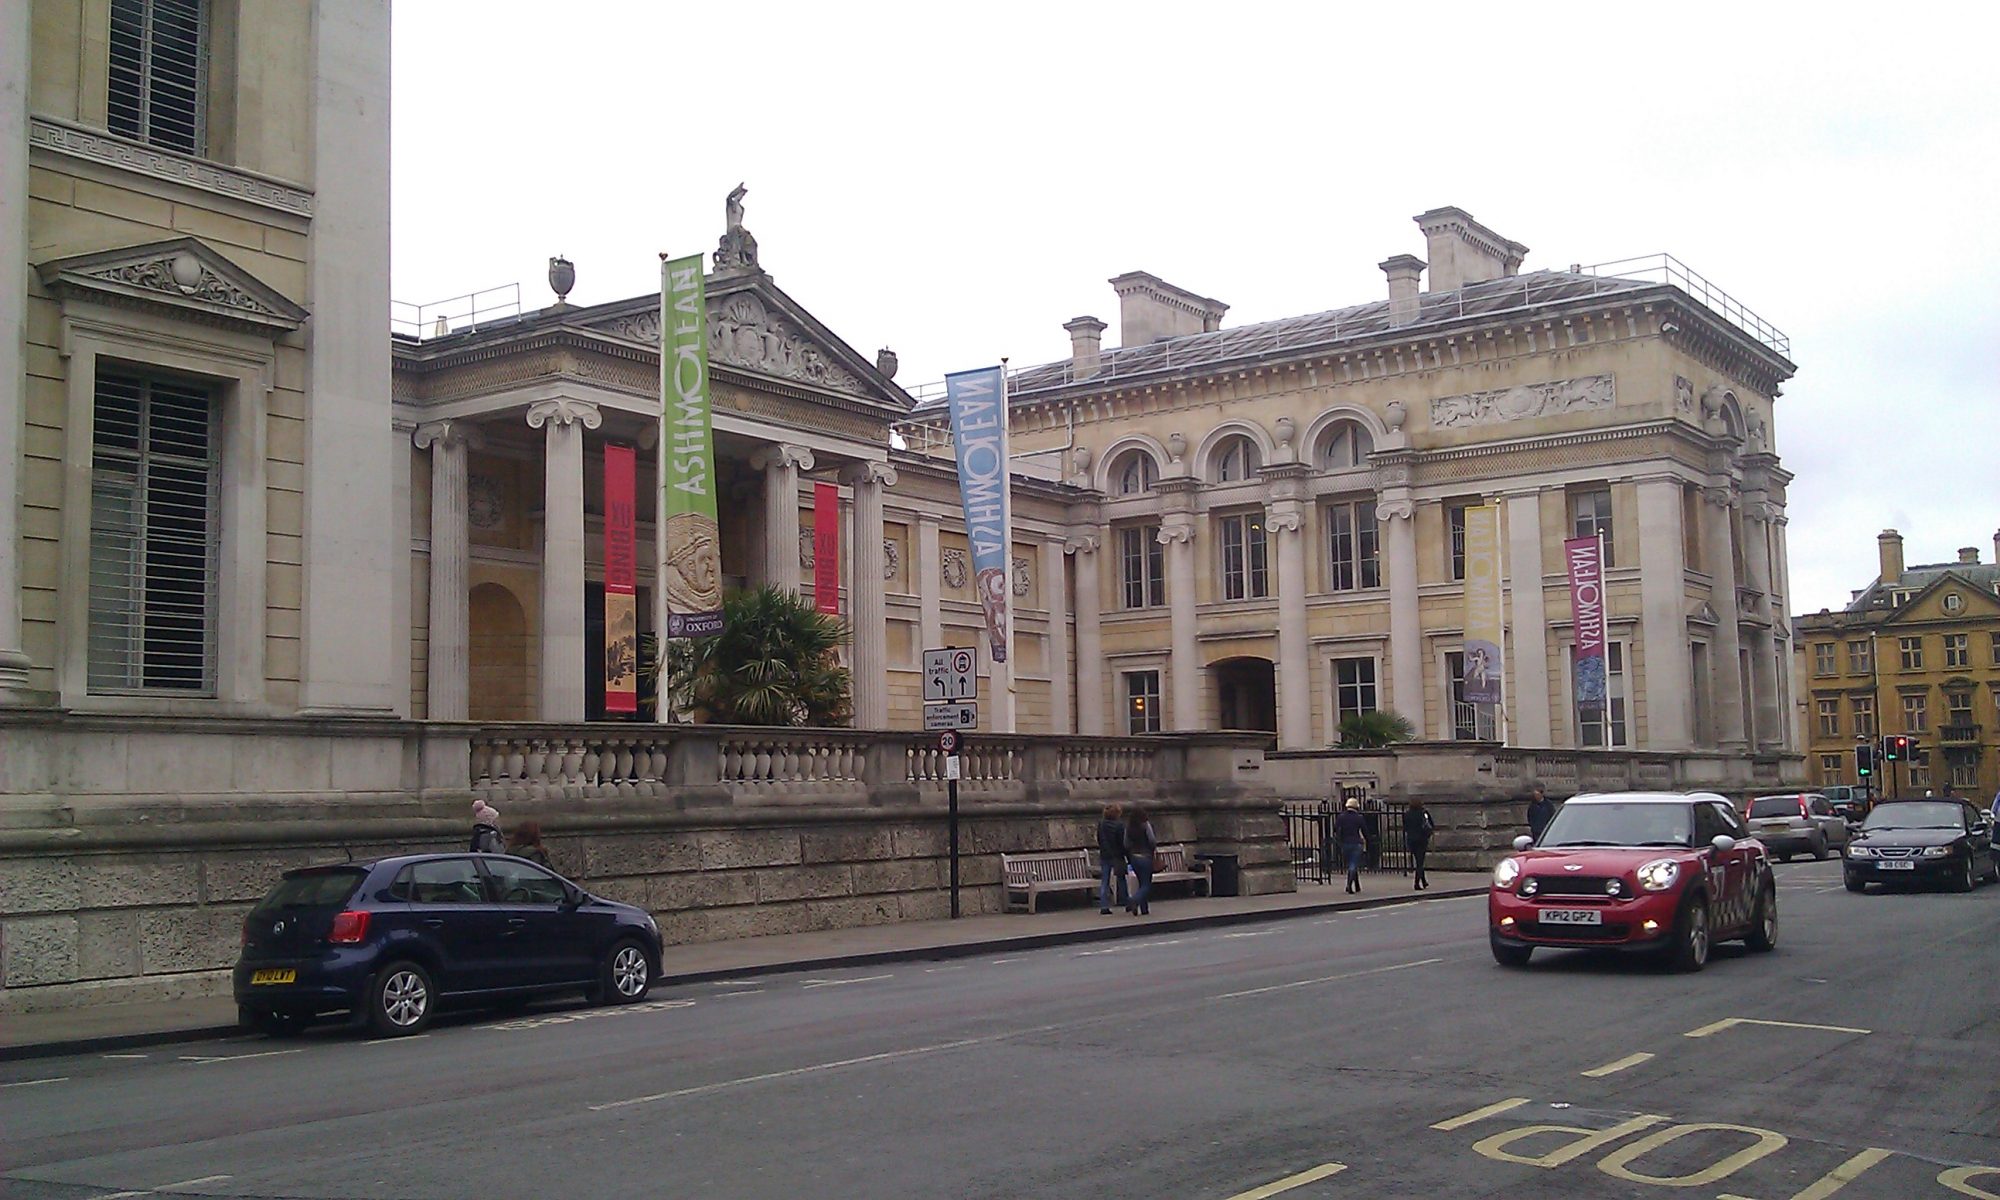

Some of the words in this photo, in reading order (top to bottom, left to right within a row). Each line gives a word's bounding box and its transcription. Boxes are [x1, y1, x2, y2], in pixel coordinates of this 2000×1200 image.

[671, 266, 706, 495] ASHMOLEAN
[686, 620, 723, 632] OXFORD
[928, 666, 949, 676] traffic
[943, 737, 953, 746] 20
[1545, 911, 1570, 921] KP12
[1572, 911, 1595, 922] GPZ
